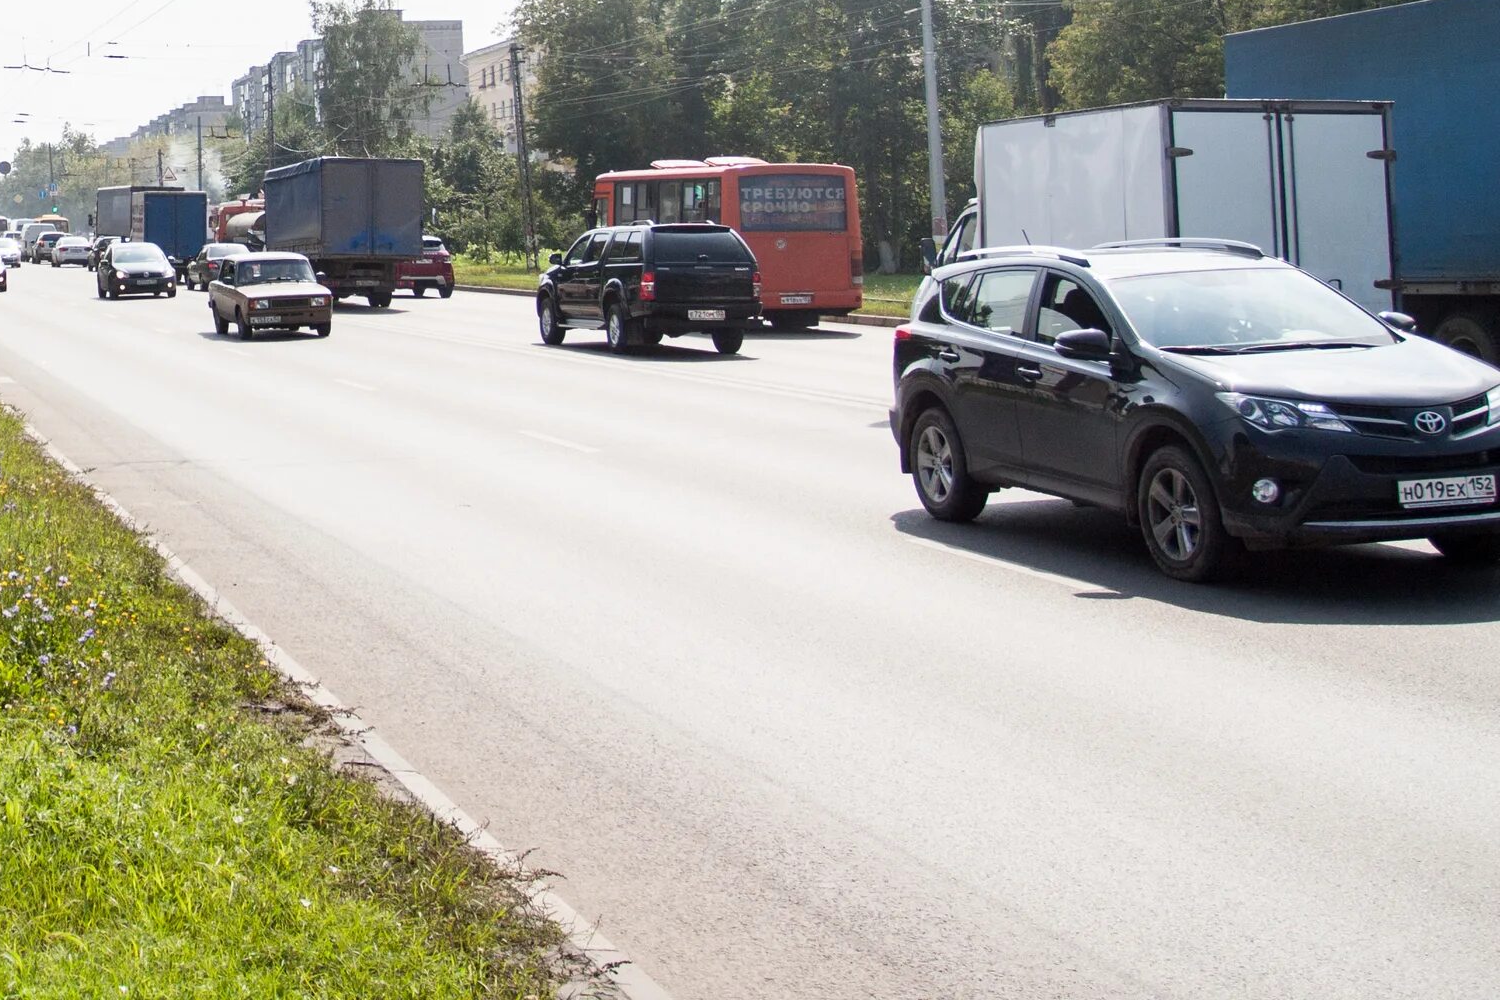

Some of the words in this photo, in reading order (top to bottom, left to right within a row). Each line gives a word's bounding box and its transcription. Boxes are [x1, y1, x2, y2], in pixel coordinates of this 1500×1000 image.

[741, 187, 844, 199] ТРЕБУЮТСЯ
[742, 201, 810, 213] СРОЧНО
[1403, 481, 1466, 500] Н019ЕХ
[1468, 477, 1492, 491] 152
